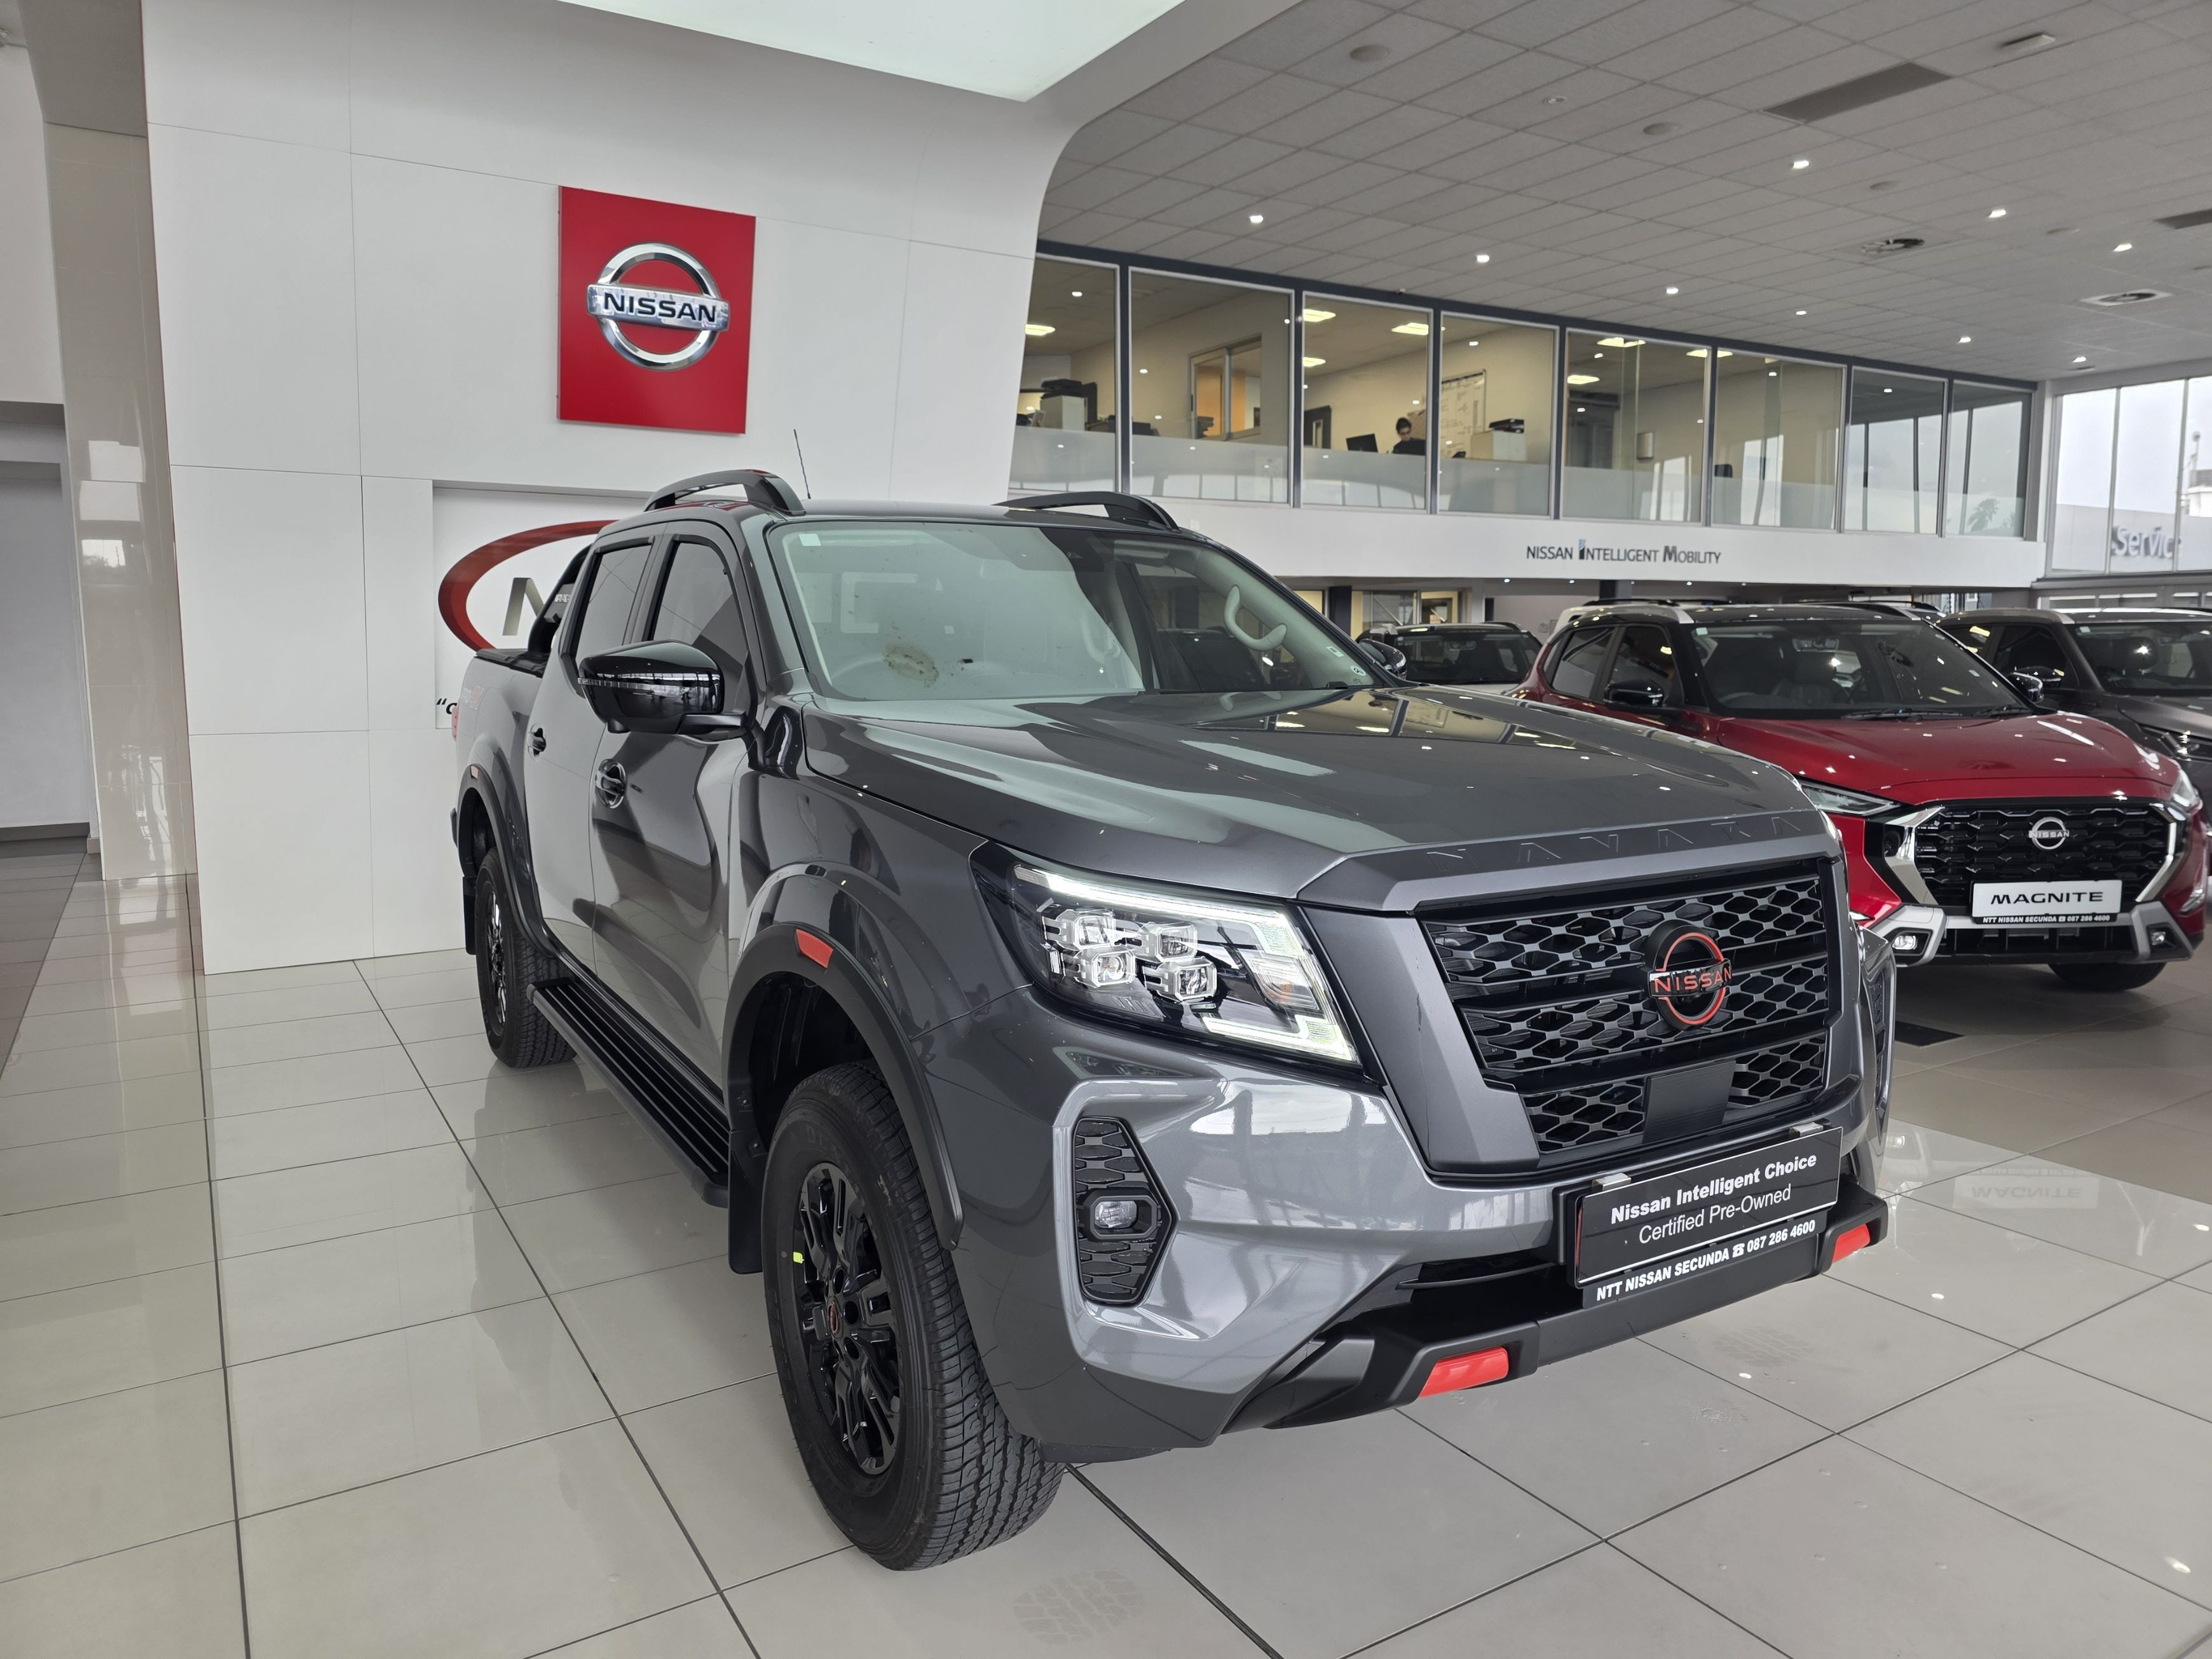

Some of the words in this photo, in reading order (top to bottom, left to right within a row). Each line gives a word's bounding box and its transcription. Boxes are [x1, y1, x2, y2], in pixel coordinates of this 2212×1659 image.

[603, 293, 716, 322] NISSAN
[1526, 546, 1573, 559] NISSAN
[1578, 539, 1660, 562] INTELLIGENT
[1663, 545, 1721, 564] MOBILITY
[2029, 830, 2070, 838] NISSAN
[1991, 892, 2103, 905] MAGNITE
[1654, 966, 1731, 993] NISSAN
[1611, 1195, 1670, 1224] Nissan
[1677, 1168, 1759, 1205] Intelligent
[1765, 1154, 1817, 1180] Choice
[1639, 1212, 1703, 1244] Certified
[1709, 1184, 1791, 1224] Pre-Owned
[1597, 1281, 1623, 1301] NTT
[1625, 1265, 1671, 1292] NISSAN
[1674, 1248, 1729, 1276] SECUNDA
[1747, 1235, 1765, 1253] 087
[1768, 1228, 1787, 1246] 286
[1790, 1219, 1815, 1238] 4600
